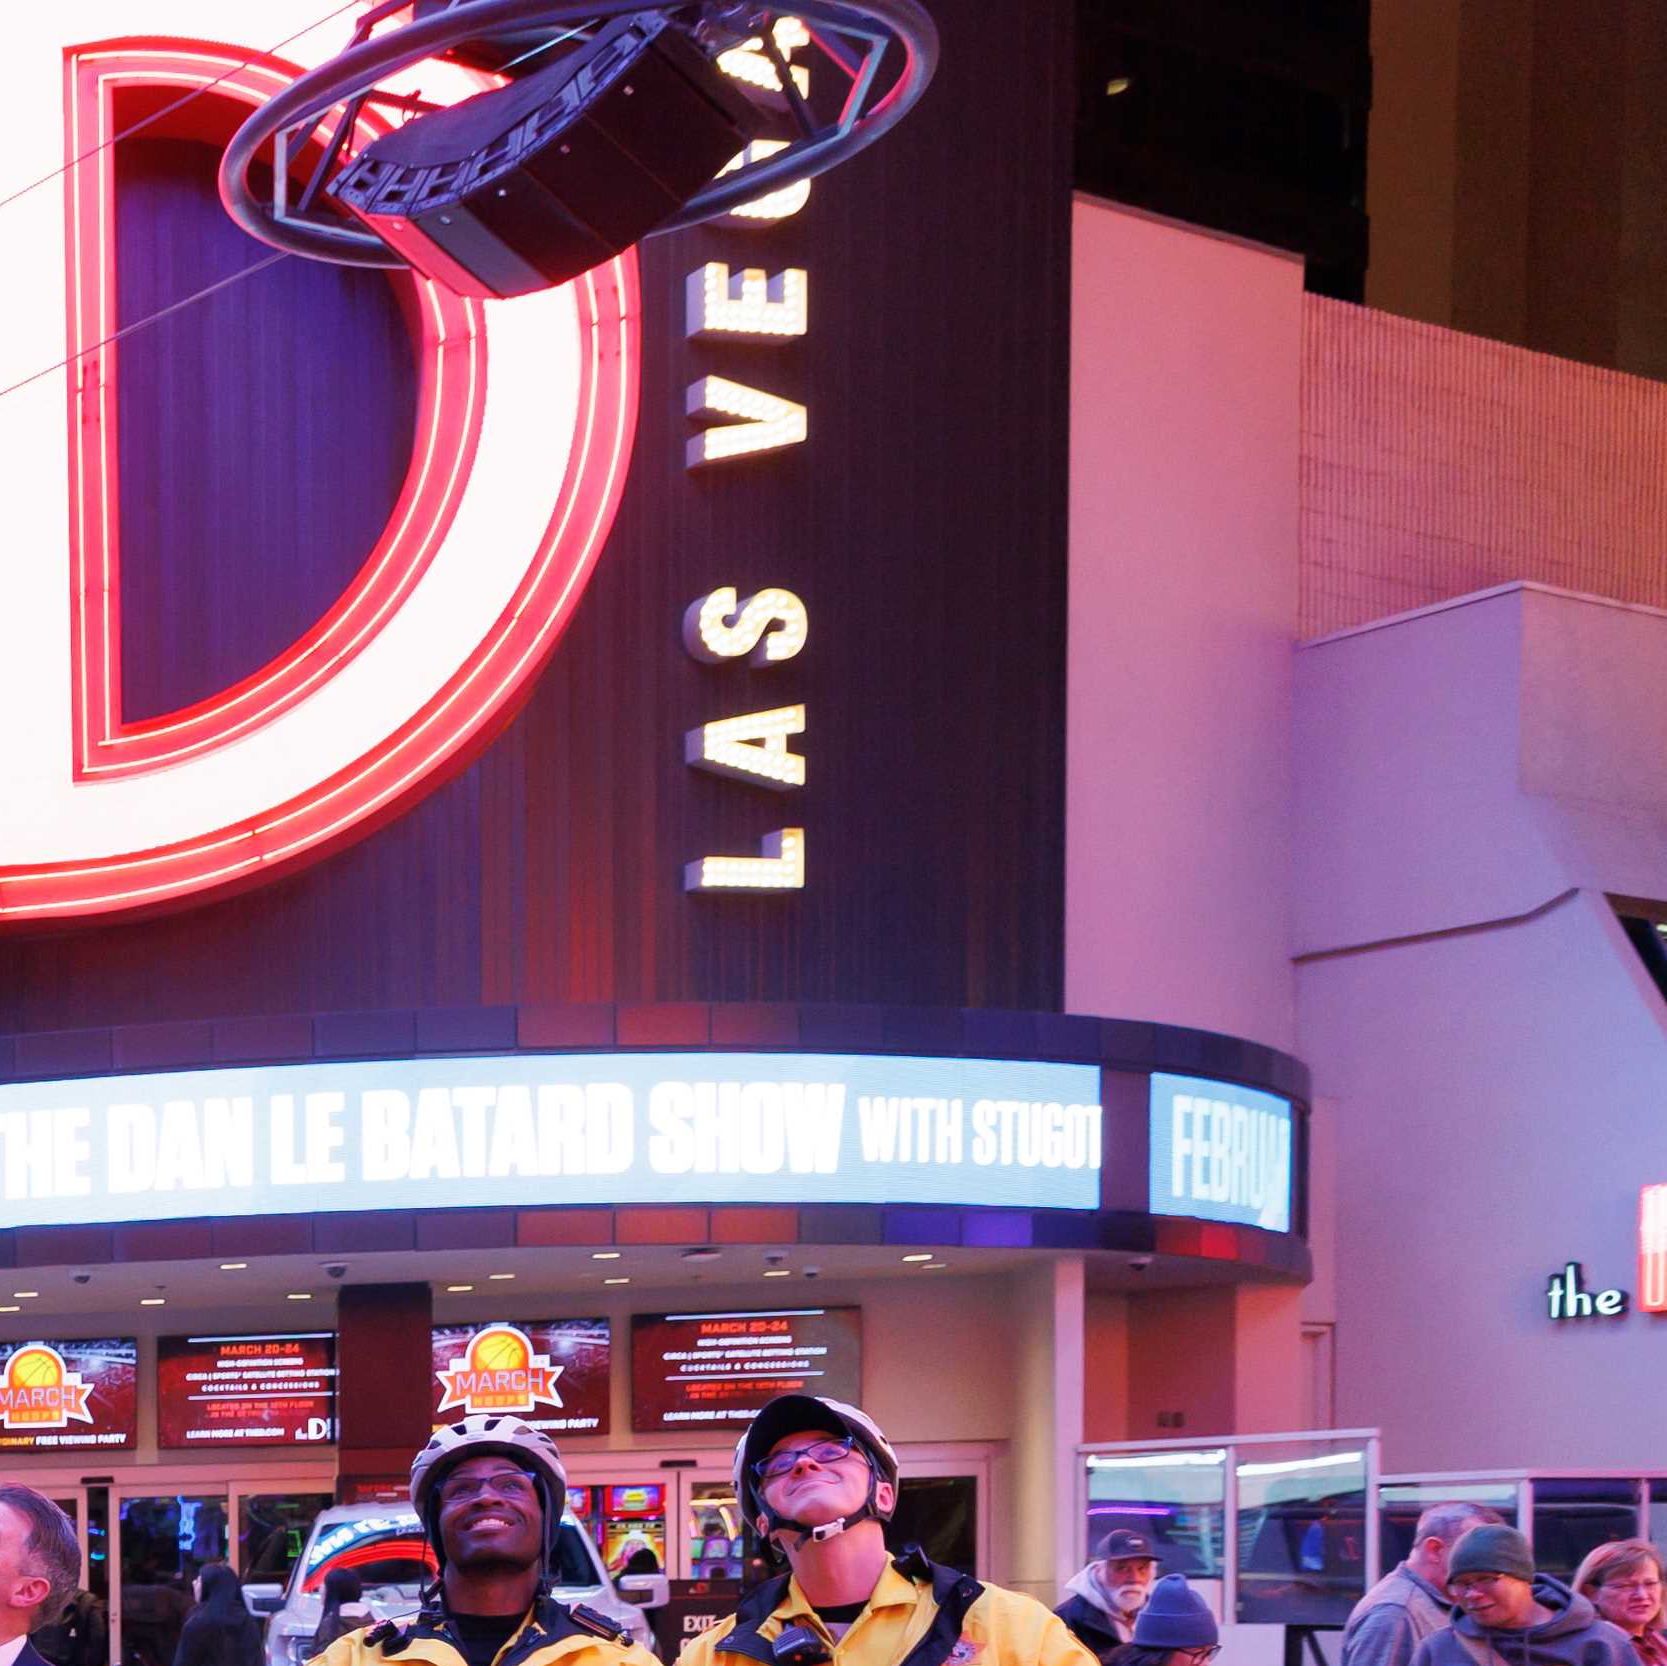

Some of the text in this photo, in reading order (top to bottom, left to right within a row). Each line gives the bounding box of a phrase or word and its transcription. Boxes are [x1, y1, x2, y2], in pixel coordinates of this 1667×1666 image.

[683, 584, 810, 896] LAS
[107, 1097, 254, 1196] DAN
[270, 1086, 346, 1185] LE
[362, 1081, 634, 1182] BATARD
[648, 1081, 845, 1175] SHOW
[858, 1096, 963, 1165] WITH
[1548, 1262, 1624, 1320] the
[701, 1323, 746, 1334] MARCH
[220, 1345, 262, 1356] MARCH
[454, 1368, 544, 1392] MARCH
[683, 1615, 717, 1632] EXIT
